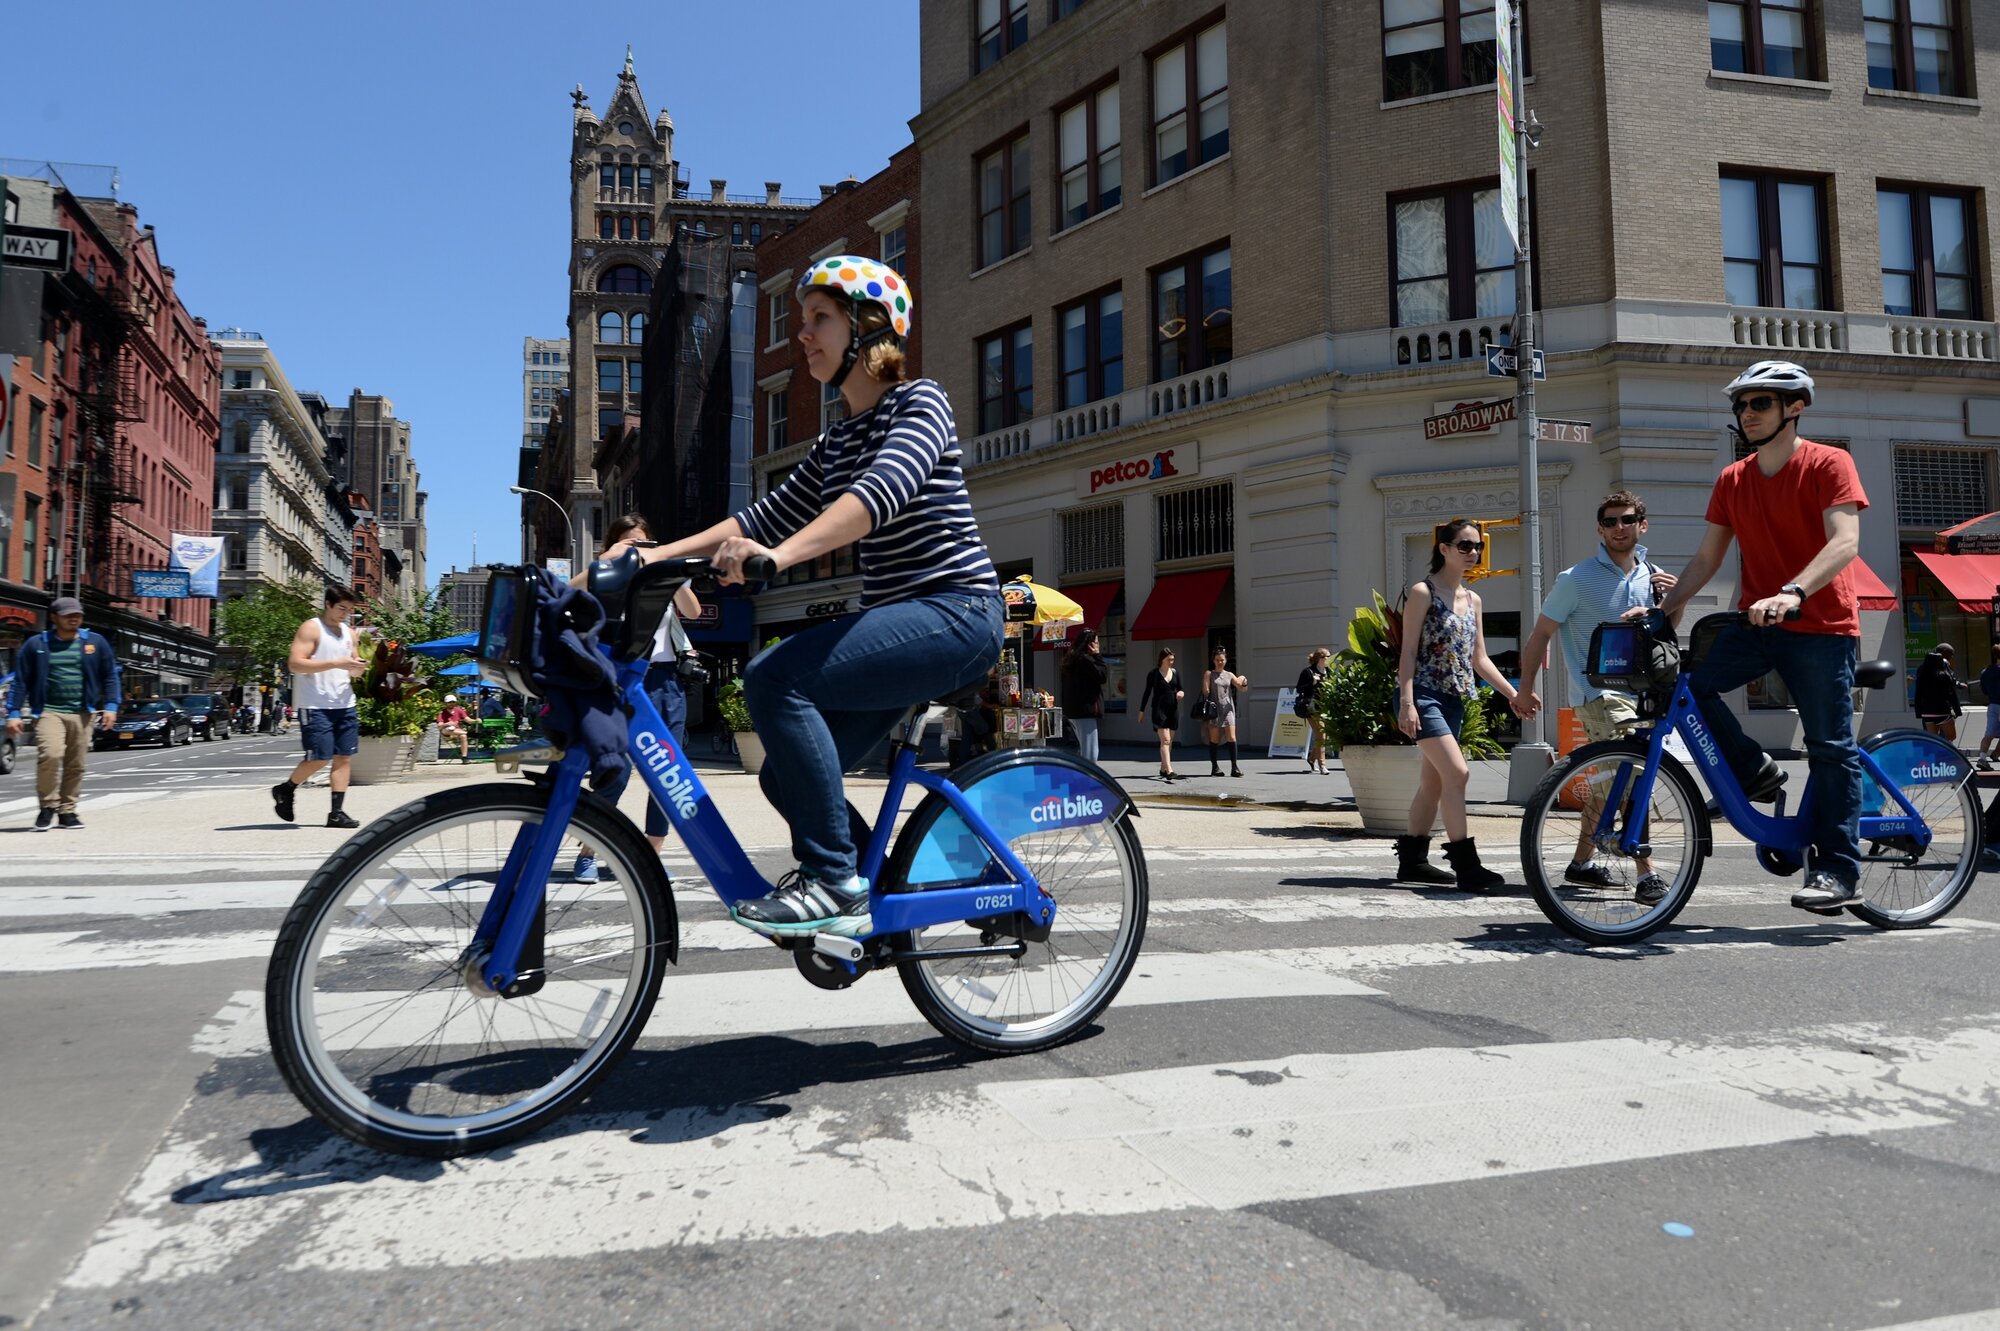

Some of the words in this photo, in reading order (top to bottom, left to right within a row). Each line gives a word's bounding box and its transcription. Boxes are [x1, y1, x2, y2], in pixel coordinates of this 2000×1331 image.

[6, 236, 49, 257] WAY
[1498, 355, 1515, 369] ONE
[1426, 402, 1512, 438] BROADWAY
[1540, 422, 1549, 439] E
[1554, 423, 1567, 441] 17
[1573, 426, 1590, 444] ST
[1090, 459, 1150, 493] petco
[805, 600, 848, 617] GEOX
[1880, 822, 1906, 832] 05744
[975, 894, 1013, 910] 07621
